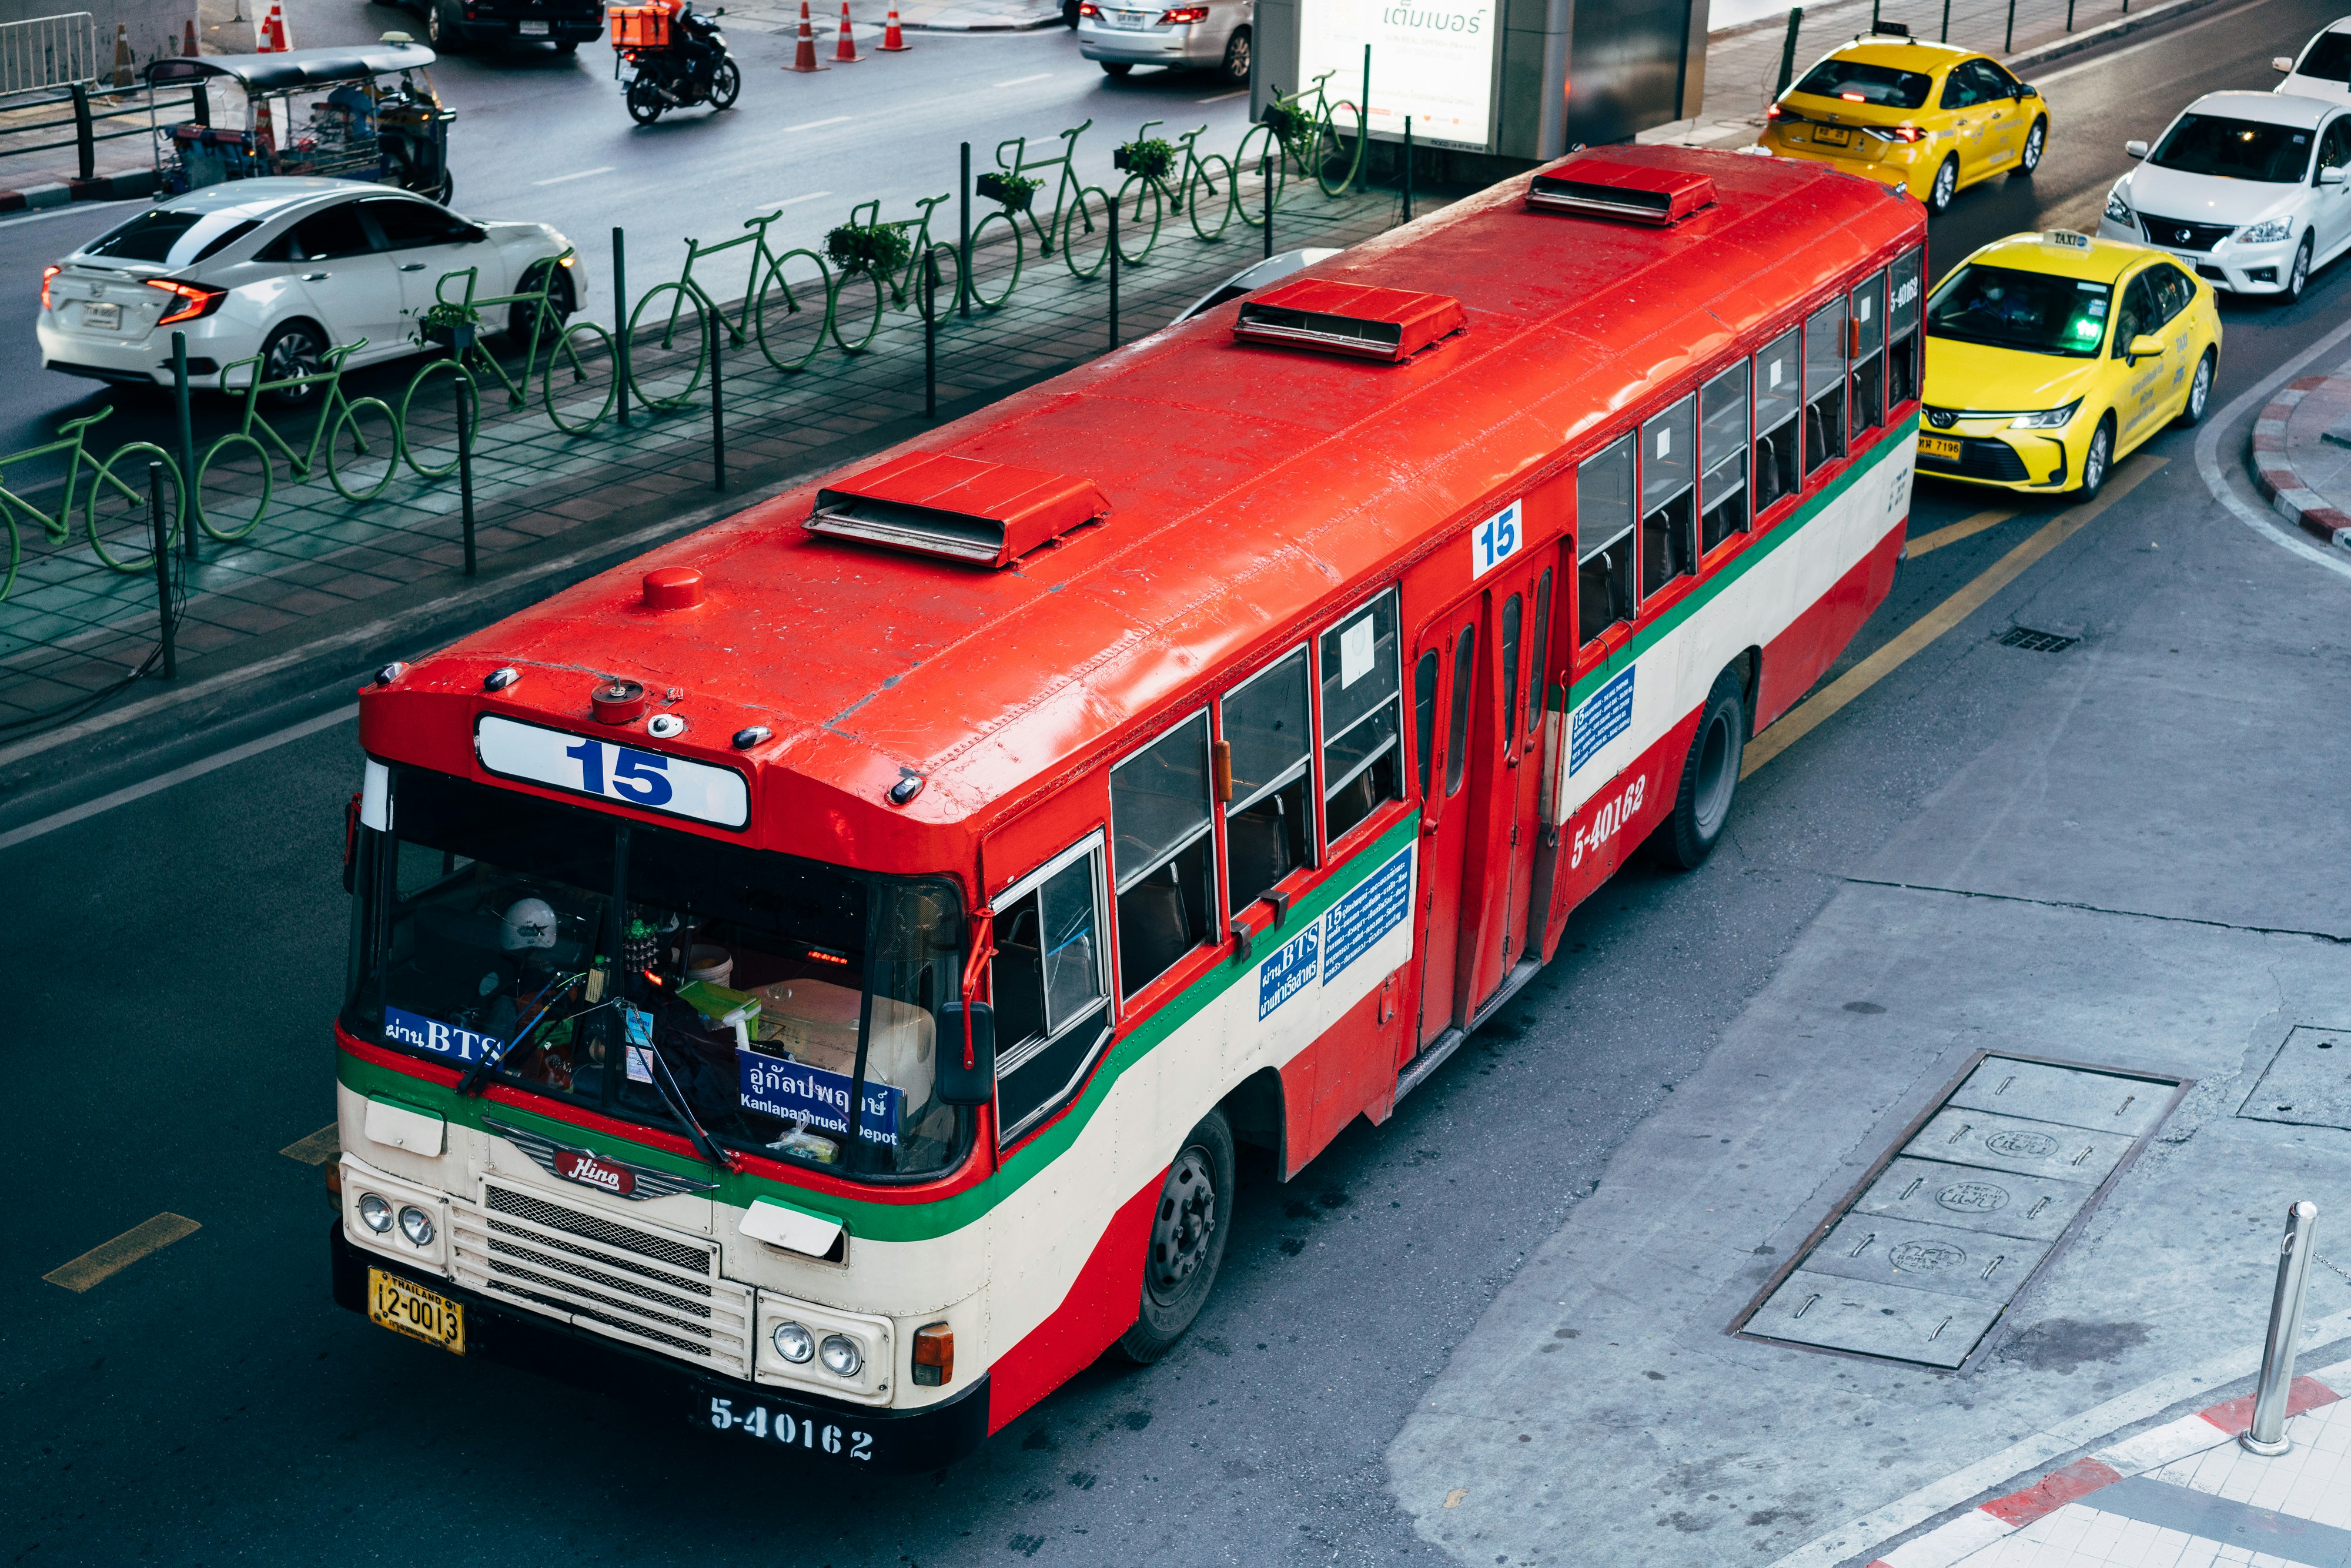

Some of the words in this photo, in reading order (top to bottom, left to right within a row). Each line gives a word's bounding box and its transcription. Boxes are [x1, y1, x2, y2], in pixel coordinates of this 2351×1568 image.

[2054, 232, 2077, 246] TAXI
[1890, 276, 1918, 313] 5-40162
[2176, 332, 2188, 354] TAXI
[1480, 507, 1515, 567] 15
[1573, 707, 1585, 731] 15
[566, 738, 674, 807] 15
[1570, 774, 1647, 870] 5-40162
[1326, 904, 1342, 932] 15
[1262, 964, 1282, 988] ผ่าน
[1281, 924, 1318, 973] BTS
[1260, 959, 1317, 1017] ผ่านท่าเรือสาทร
[385, 1018, 425, 1048] ผ่าน
[424, 1021, 504, 1068] BTS
[750, 1062, 888, 1116] อู่กัลปพฤษ์
[859, 1124, 897, 1146] epot
[567, 1157, 620, 1191] Hino
[379, 1283, 458, 1341] 12-0013
[392, 1278, 442, 1305] THAILAND
[710, 1396, 874, 1461] 5-40162
